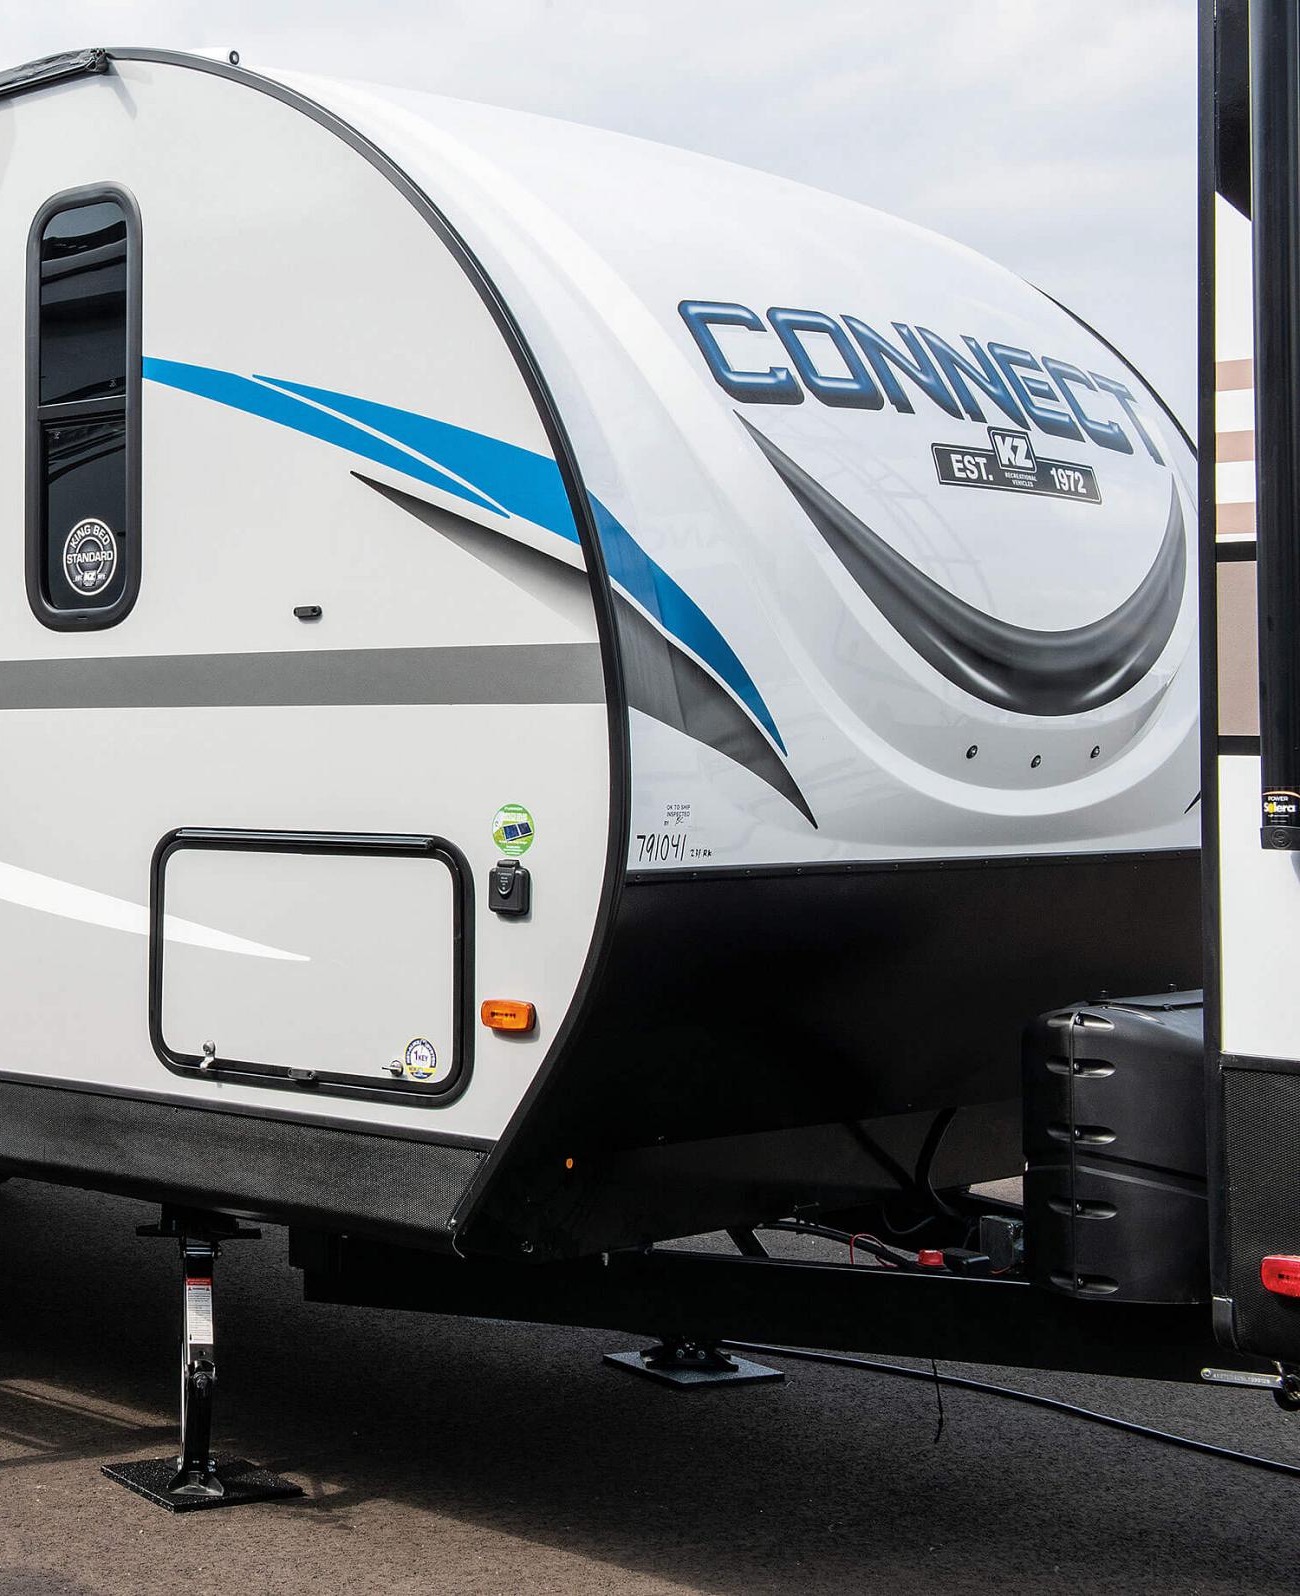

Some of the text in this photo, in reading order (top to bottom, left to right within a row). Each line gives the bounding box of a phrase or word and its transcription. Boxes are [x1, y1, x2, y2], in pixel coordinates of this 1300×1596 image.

[677, 299, 1166, 467] CONNECT
[950, 434, 1087, 494] EST. KZ 1972
[1004, 471, 1038, 482] RECREATIONAL
[1011, 479, 1035, 487] VEHICLES
[70, 525, 110, 548] KING BED
[67, 551, 113, 564] STANDARD
[1264, 802, 1296, 813] Solera
[637, 834, 686, 862] 791041
